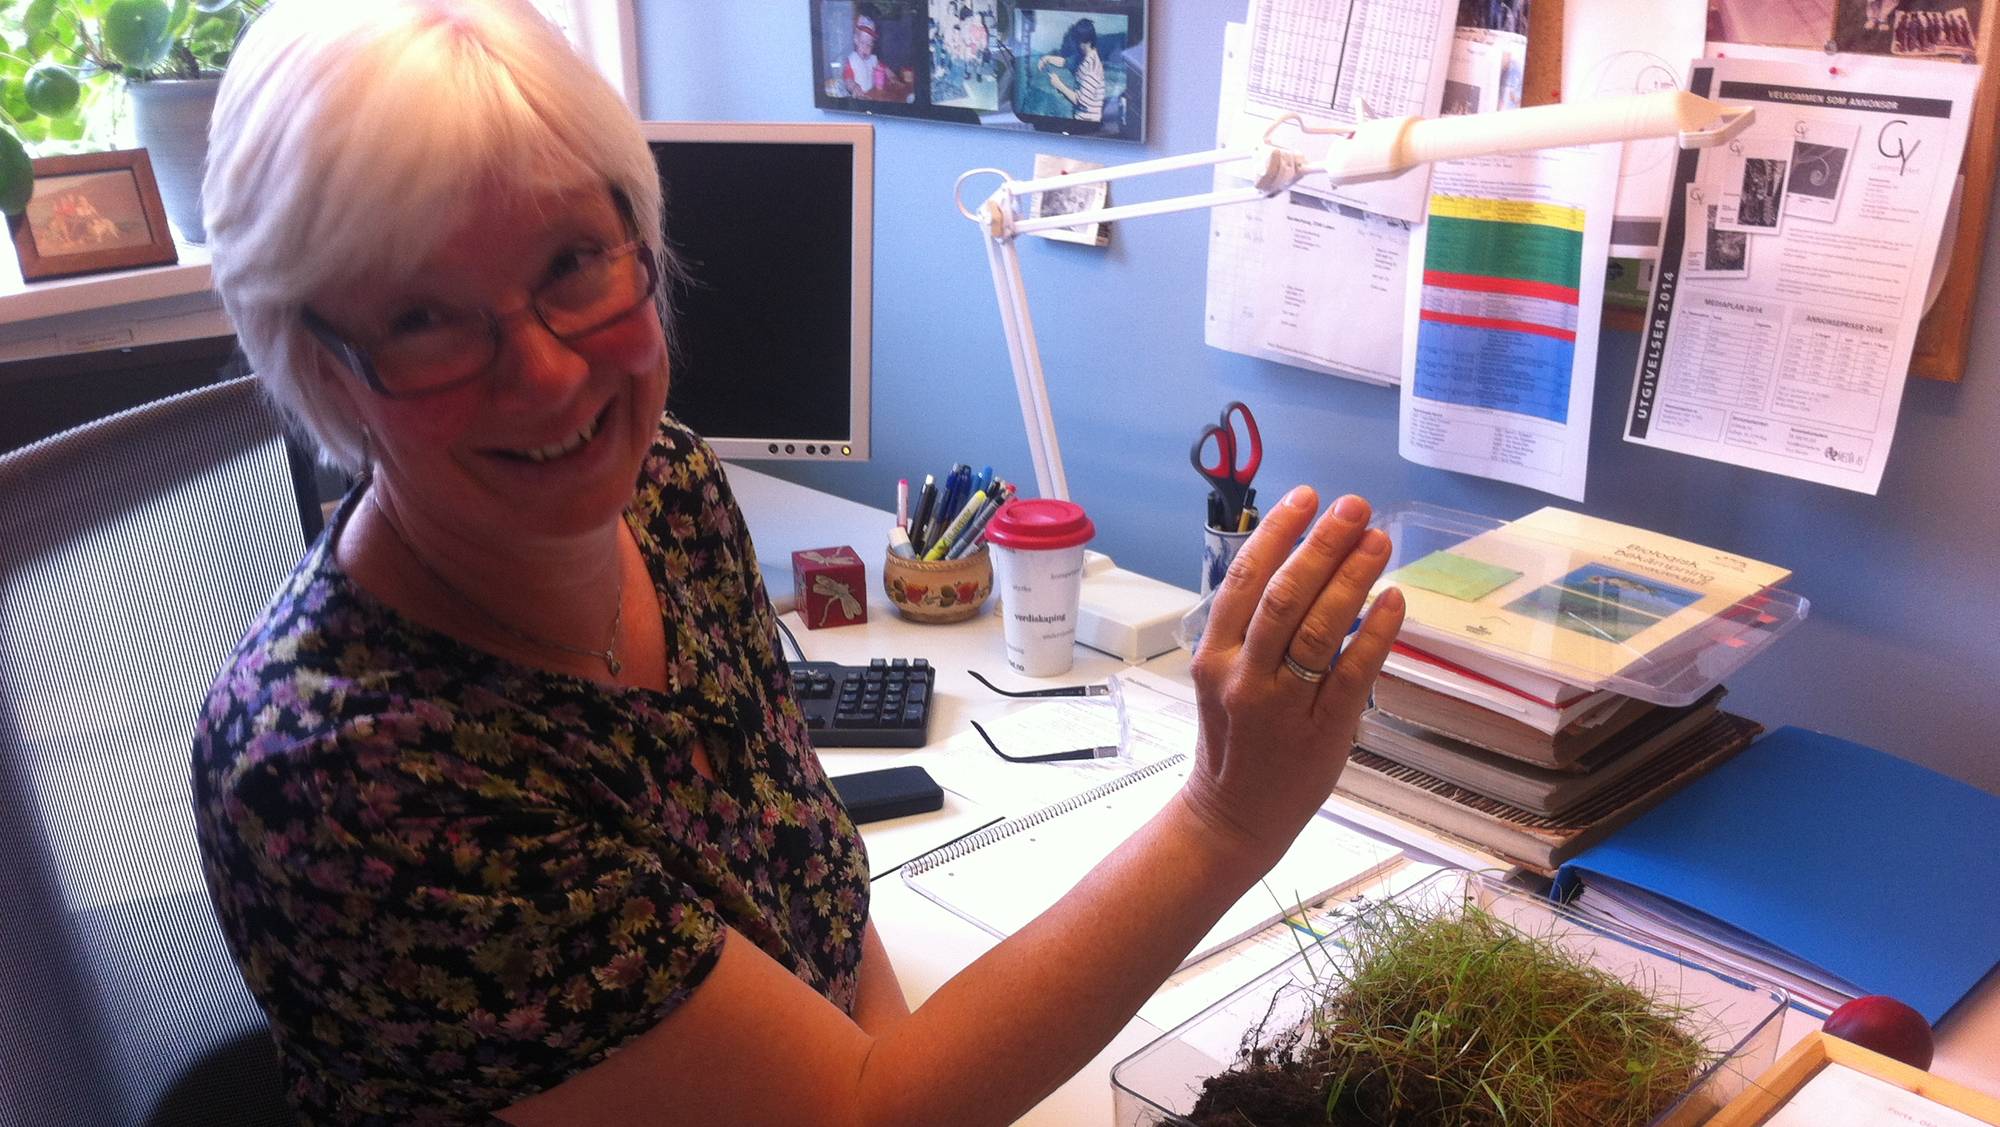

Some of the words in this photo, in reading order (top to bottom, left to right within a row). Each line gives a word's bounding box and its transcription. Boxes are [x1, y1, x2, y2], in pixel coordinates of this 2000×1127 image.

[1768, 90, 1825, 104] VELKOMMEN
[1826, 95, 1848, 106] SOM
[1745, 305, 1764, 314] 2014
[1637, 319, 1667, 420] UTGIVELSER
[1658, 271, 1675, 312] 2014
[1626, 543, 1697, 569] Biologisk
[1014, 613, 1067, 624] verdiskaping
